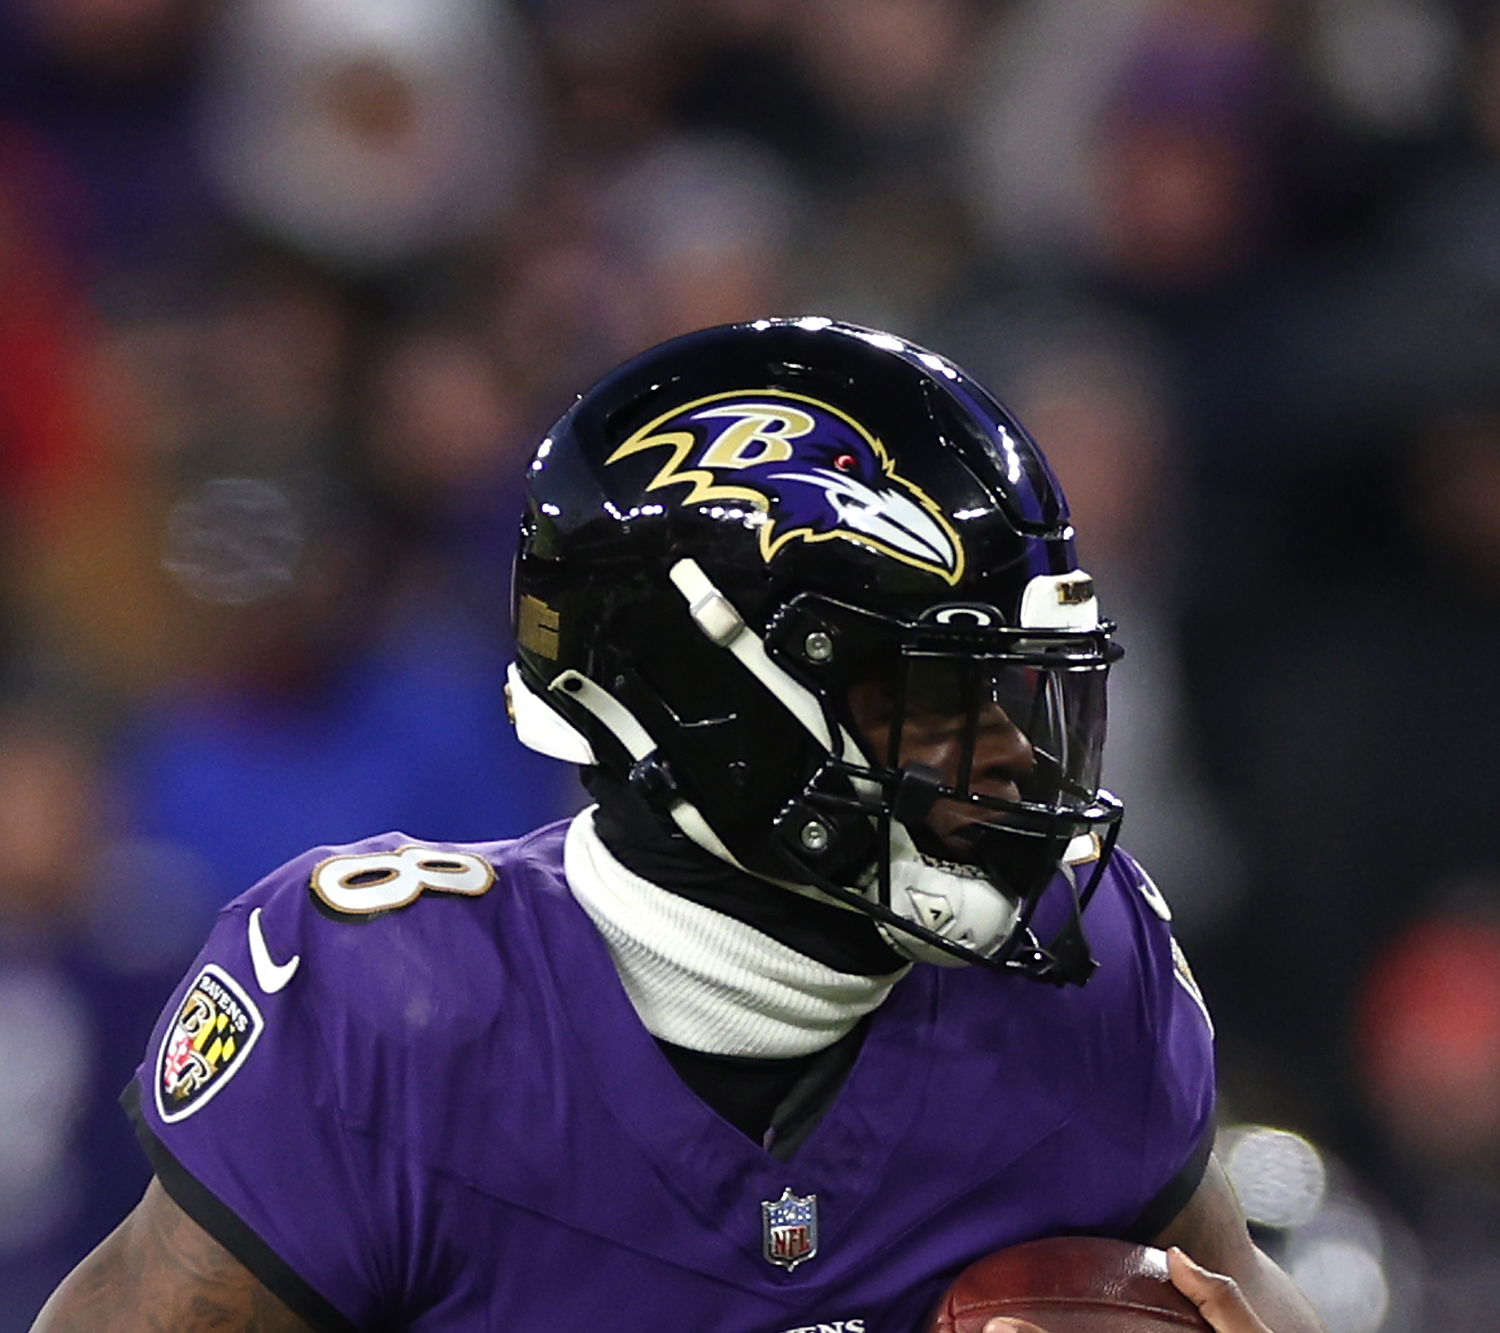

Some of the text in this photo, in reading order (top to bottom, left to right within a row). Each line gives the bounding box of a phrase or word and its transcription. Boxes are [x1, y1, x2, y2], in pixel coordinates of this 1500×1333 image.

[308, 844, 500, 925] 8
[199, 975, 249, 1033] RAVENS
[771, 1228, 811, 1258] NFL
